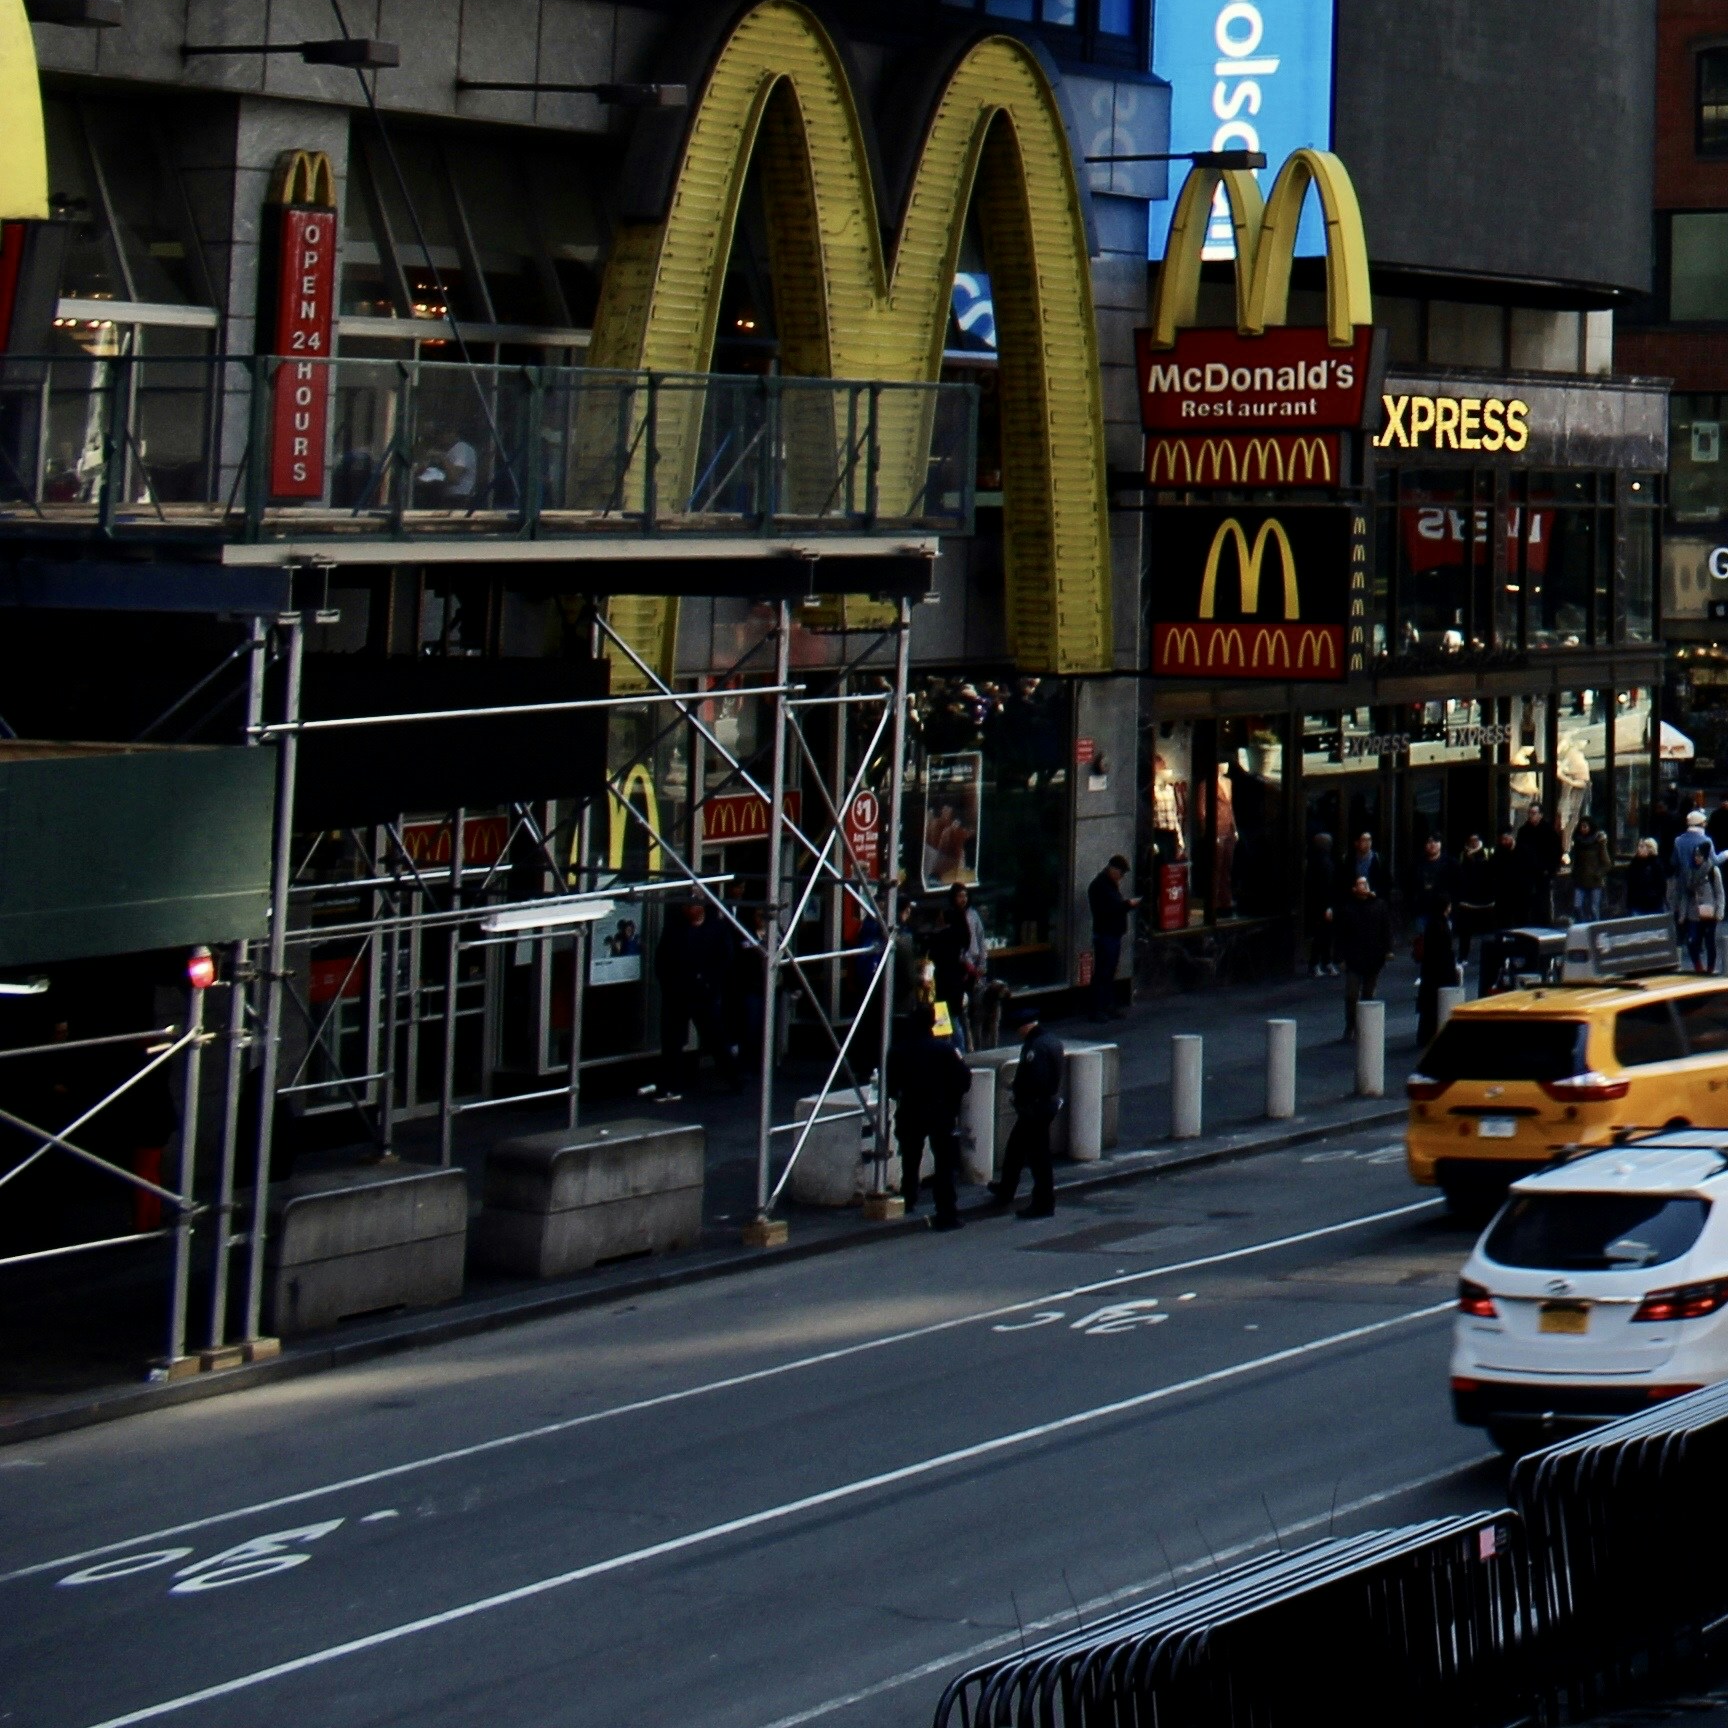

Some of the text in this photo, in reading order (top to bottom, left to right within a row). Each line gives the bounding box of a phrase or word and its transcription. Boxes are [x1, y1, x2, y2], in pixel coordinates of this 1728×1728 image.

[292, 223, 321, 485] OPEN 24 HOURS
[1148, 359, 1354, 397] McDonald's
[1181, 396, 1318, 419] Restaurant
[1373, 393, 1530, 453] XPRESS
[856, 798, 872, 824] $1
